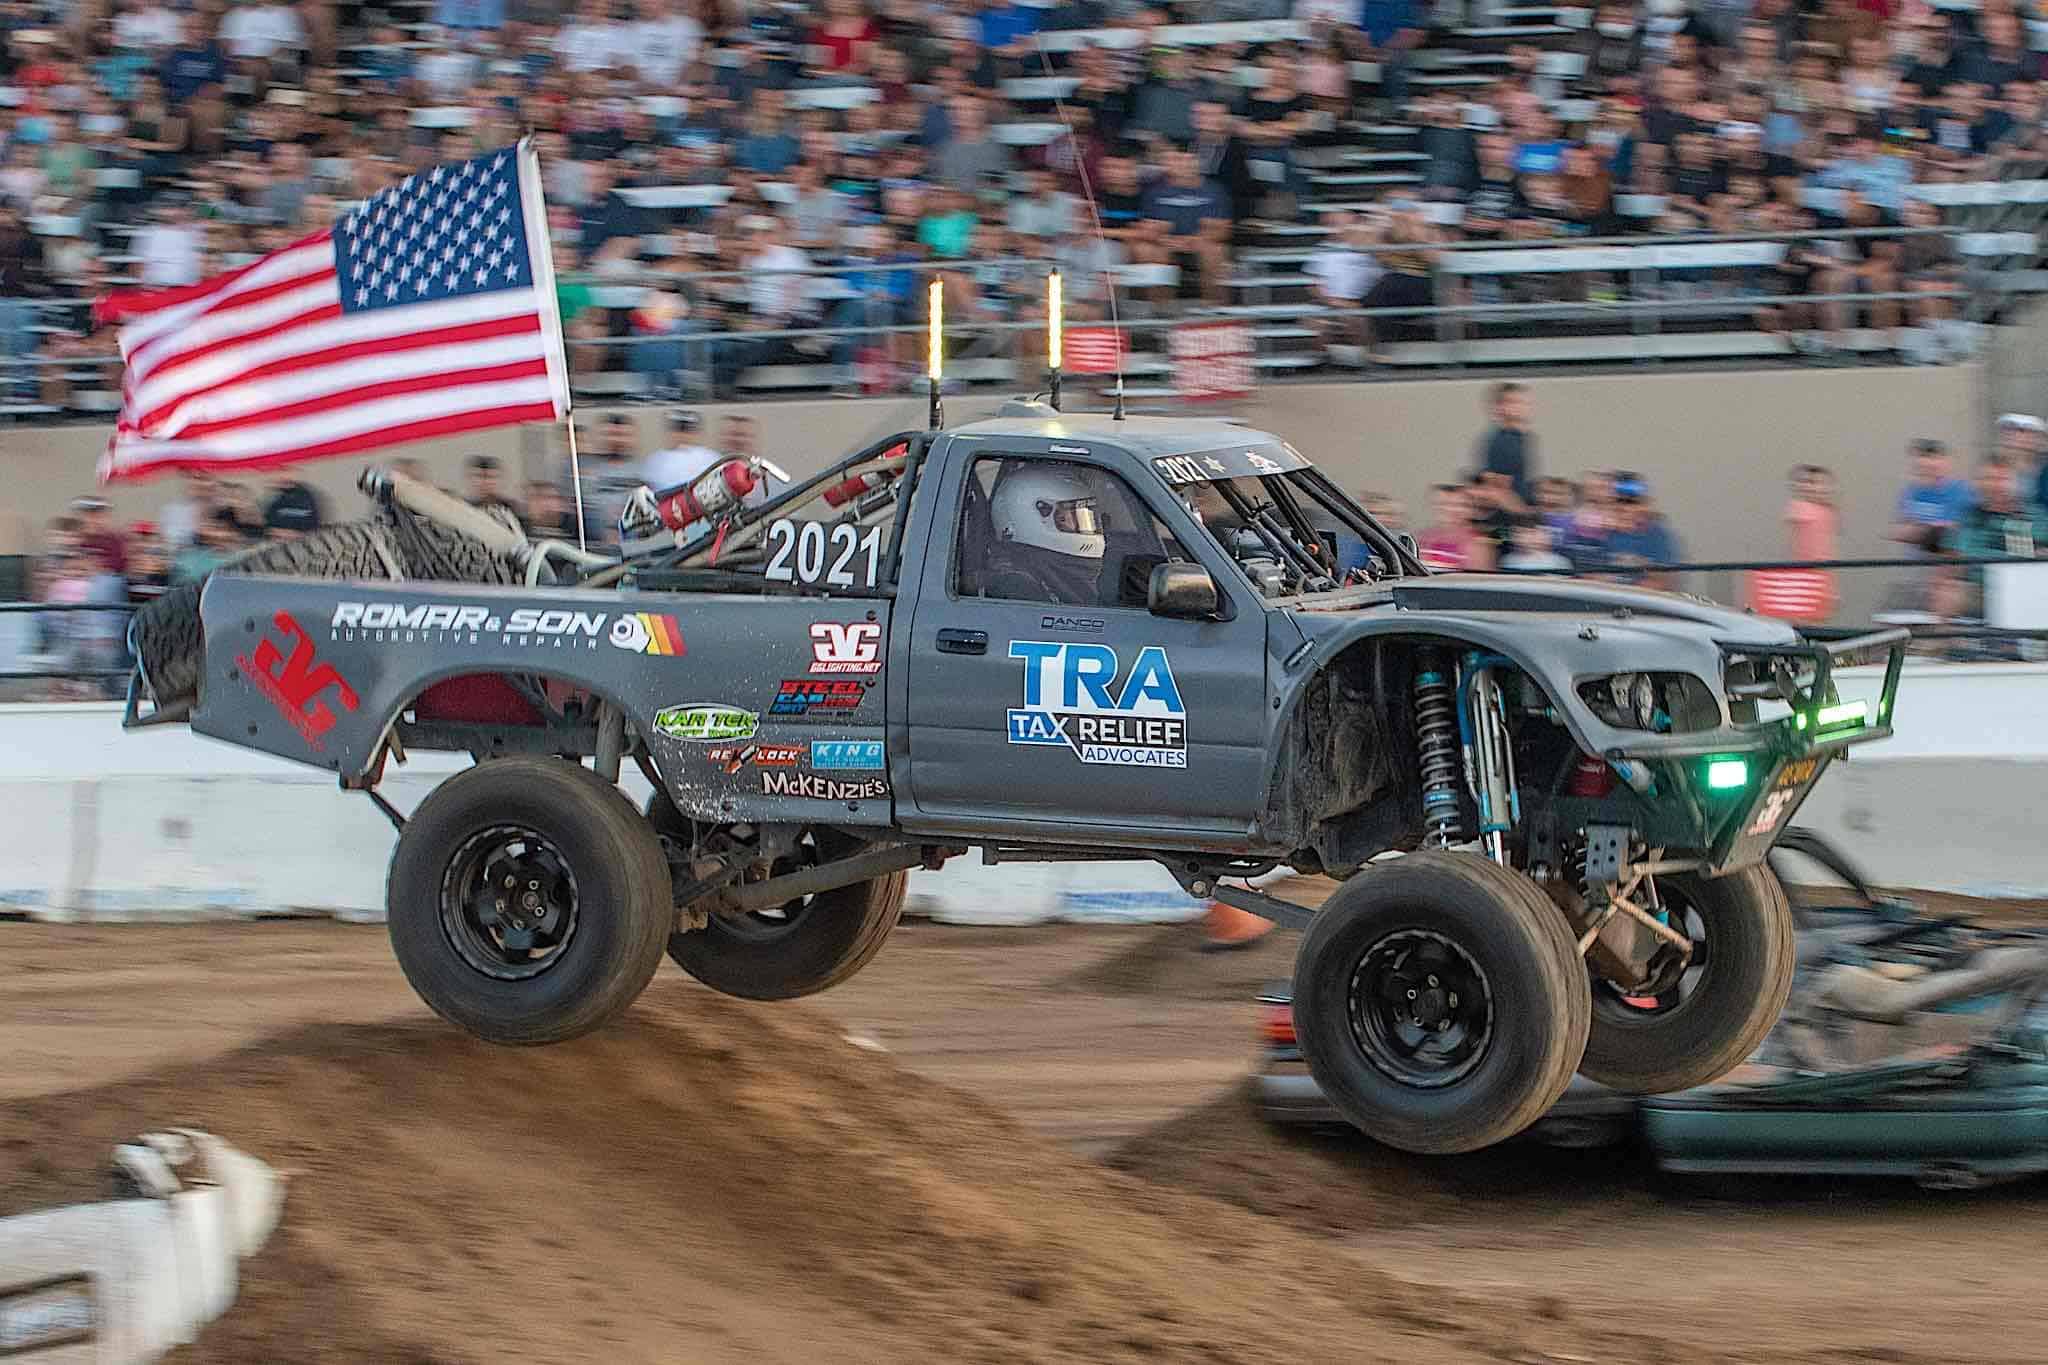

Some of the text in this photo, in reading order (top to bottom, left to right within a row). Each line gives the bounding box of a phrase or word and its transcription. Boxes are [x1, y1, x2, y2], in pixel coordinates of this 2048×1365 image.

[765, 519, 881, 588] 2021
[331, 602, 489, 632] ROMAR
[504, 609, 607, 636] SON
[1041, 616, 1105, 628] DANCO
[331, 629, 596, 649] AUTOMOTIVE REPAIR
[1009, 641, 1186, 713] TRA
[780, 681, 865, 694] STEEL
[1012, 714, 1182, 745] TAX RELIEF
[757, 750, 798, 761] LOCK
[816, 744, 880, 757] KING
[1084, 747, 1185, 765] ADVOCATES
